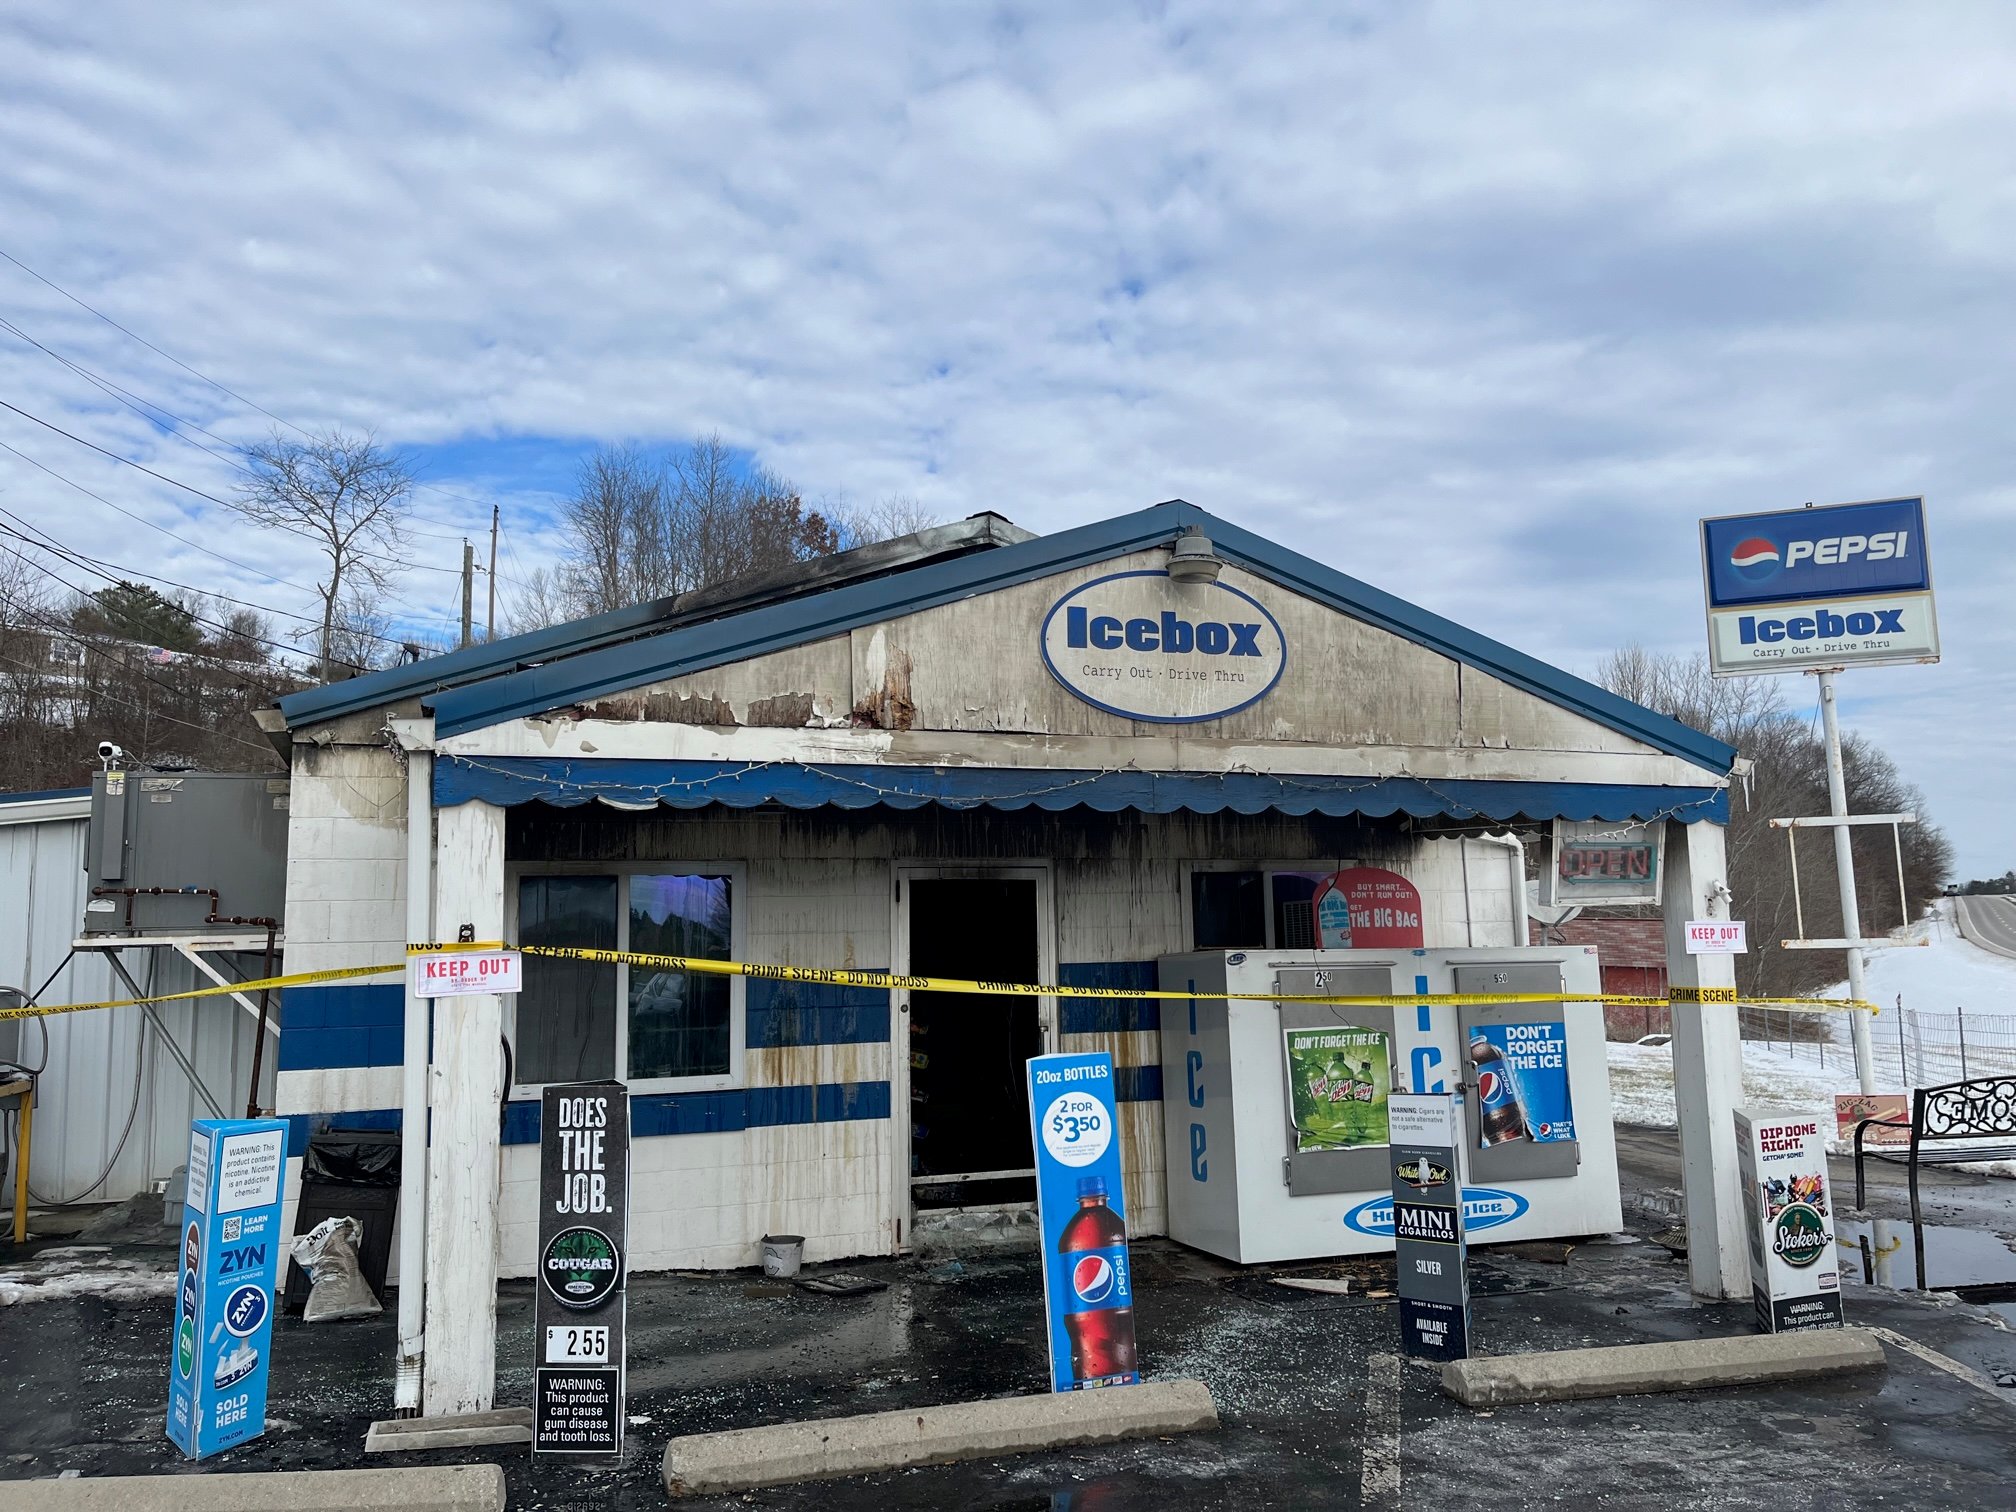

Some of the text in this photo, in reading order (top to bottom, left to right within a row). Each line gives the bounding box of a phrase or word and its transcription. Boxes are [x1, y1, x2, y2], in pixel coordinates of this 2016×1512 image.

[1785, 531, 1908, 569] PEPSI
[1066, 605, 1263, 657] Icebox
[1738, 609, 1906, 645] Icebox
[1753, 639, 1890, 658] Carry Out Drive Thru
[1082, 664, 1245, 683] Carry Out Drive Thru
[1559, 846, 1650, 877] OPEN
[1357, 883, 1372, 891] BUY
[1351, 891, 1413, 899] DON'T RUN OUT!
[1350, 908, 1418, 928] THE BIG BAG
[1691, 927, 1739, 940] KEEP OUT
[426, 960, 469, 978] KEEP
[478, 958, 511, 976] OUT
[595, 951, 612, 962] DO
[617, 953, 642, 965] NOT
[646, 956, 686, 970] CROSS
[741, 963, 929, 988] CRIME SCENE DO NOT CROSS
[977, 981, 1018, 992] CRIME
[1023, 984, 1063, 994] SCENE
[1073, 986, 1087, 995] DO
[1670, 988, 1700, 1002] CRIME
[1702, 989, 1734, 1002] SCENE
[1505, 1025, 1552, 1040] DON'T
[1294, 1032, 1380, 1050] DON'T FORGET THE ICE
[1506, 1039, 1564, 1055] FORGET
[1507, 1054, 1563, 1070] THE ICE
[1036, 1065, 1108, 1084] 20oz BOTTLES
[558, 1097, 608, 1128] DOES
[1060, 1099, 1093, 1113] 2 FOR
[1760, 1123, 1817, 1140] DIP DONE
[1843, 1132, 1878, 1141] COES
[263, 1144, 275, 1152] This
[558, 1130, 606, 1171] THE
[1761, 1138, 1804, 1153] RIGHT.
[226, 1154, 276, 1169] product contains
[251, 1164, 276, 1174] Nicotine
[1397, 1164, 1419, 1179] White
[244, 1175, 270, 1186] addictive
[555, 1172, 613, 1214] JOB.
[1472, 1202, 1503, 1213] Ice
[244, 1214, 268, 1226] LEARN
[1400, 1207, 1452, 1231] MINI
[243, 1224, 264, 1235] MORE
[1398, 1226, 1455, 1240] CIGARILLOS
[1774, 1225, 1834, 1253] Stoker's
[218, 1243, 266, 1275] ZYN
[548, 1257, 613, 1270] COUGAR
[1113, 1254, 1128, 1296] pepsi
[1415, 1259, 1442, 1276] SILVER
[231, 1290, 256, 1324] ZYN
[1790, 1301, 1825, 1314] WARNING:
[1416, 1318, 1448, 1334] AVAILABLE
[1783, 1311, 1835, 1326] This product can
[548, 1329, 605, 1356] $ 2.55
[1422, 1332, 1444, 1347] INSIDE
[549, 1378, 606, 1390] WARNING:
[216, 1393, 249, 1415] SOLD
[545, 1391, 609, 1406] This product
[215, 1407, 248, 1429] HERE
[550, 1407, 603, 1416] can cause
[544, 1417, 608, 1431] gum disease
[218, 1430, 244, 1444] ZYN.COM
[539, 1430, 613, 1442] and tooth loss.
